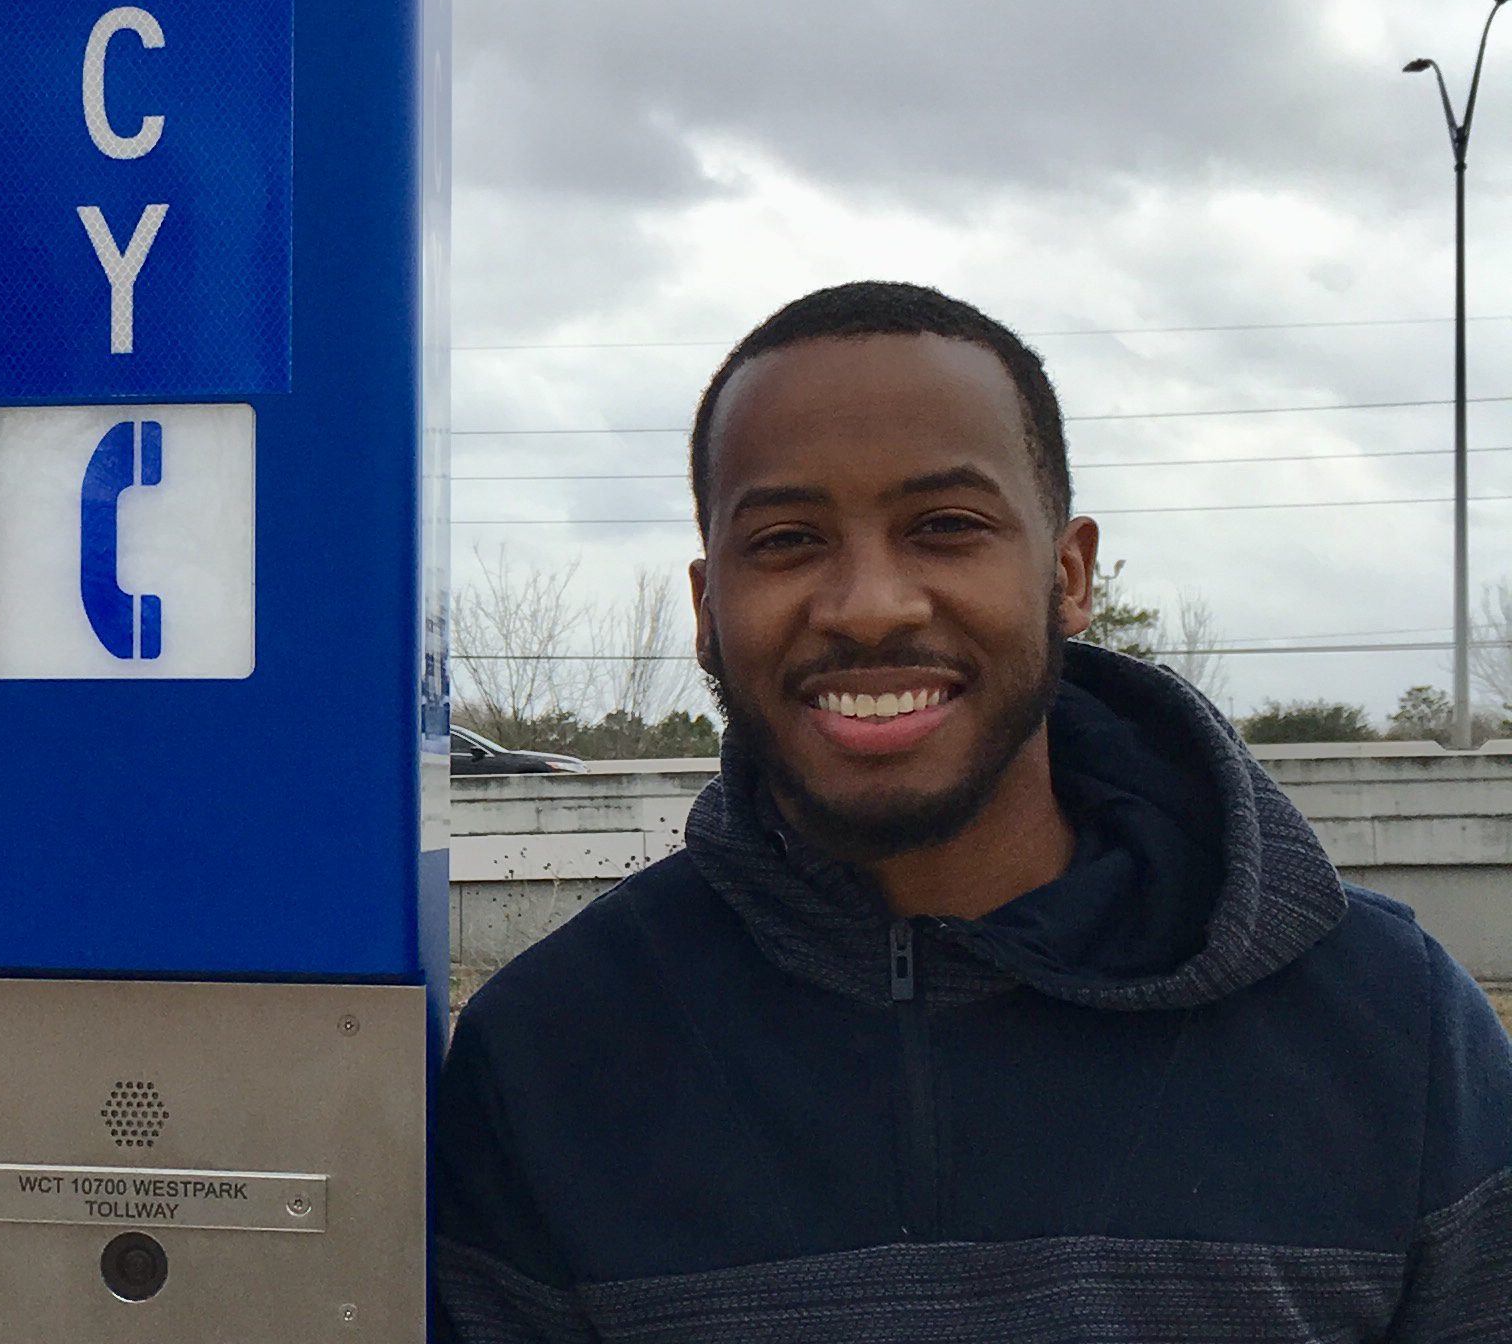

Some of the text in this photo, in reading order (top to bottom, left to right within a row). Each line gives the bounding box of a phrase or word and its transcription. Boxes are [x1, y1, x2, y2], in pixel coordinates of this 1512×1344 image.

[19, 1176, 248, 1200] WCT 10700 WESTPARK
[85, 1200, 179, 1220] TOLLWAY
